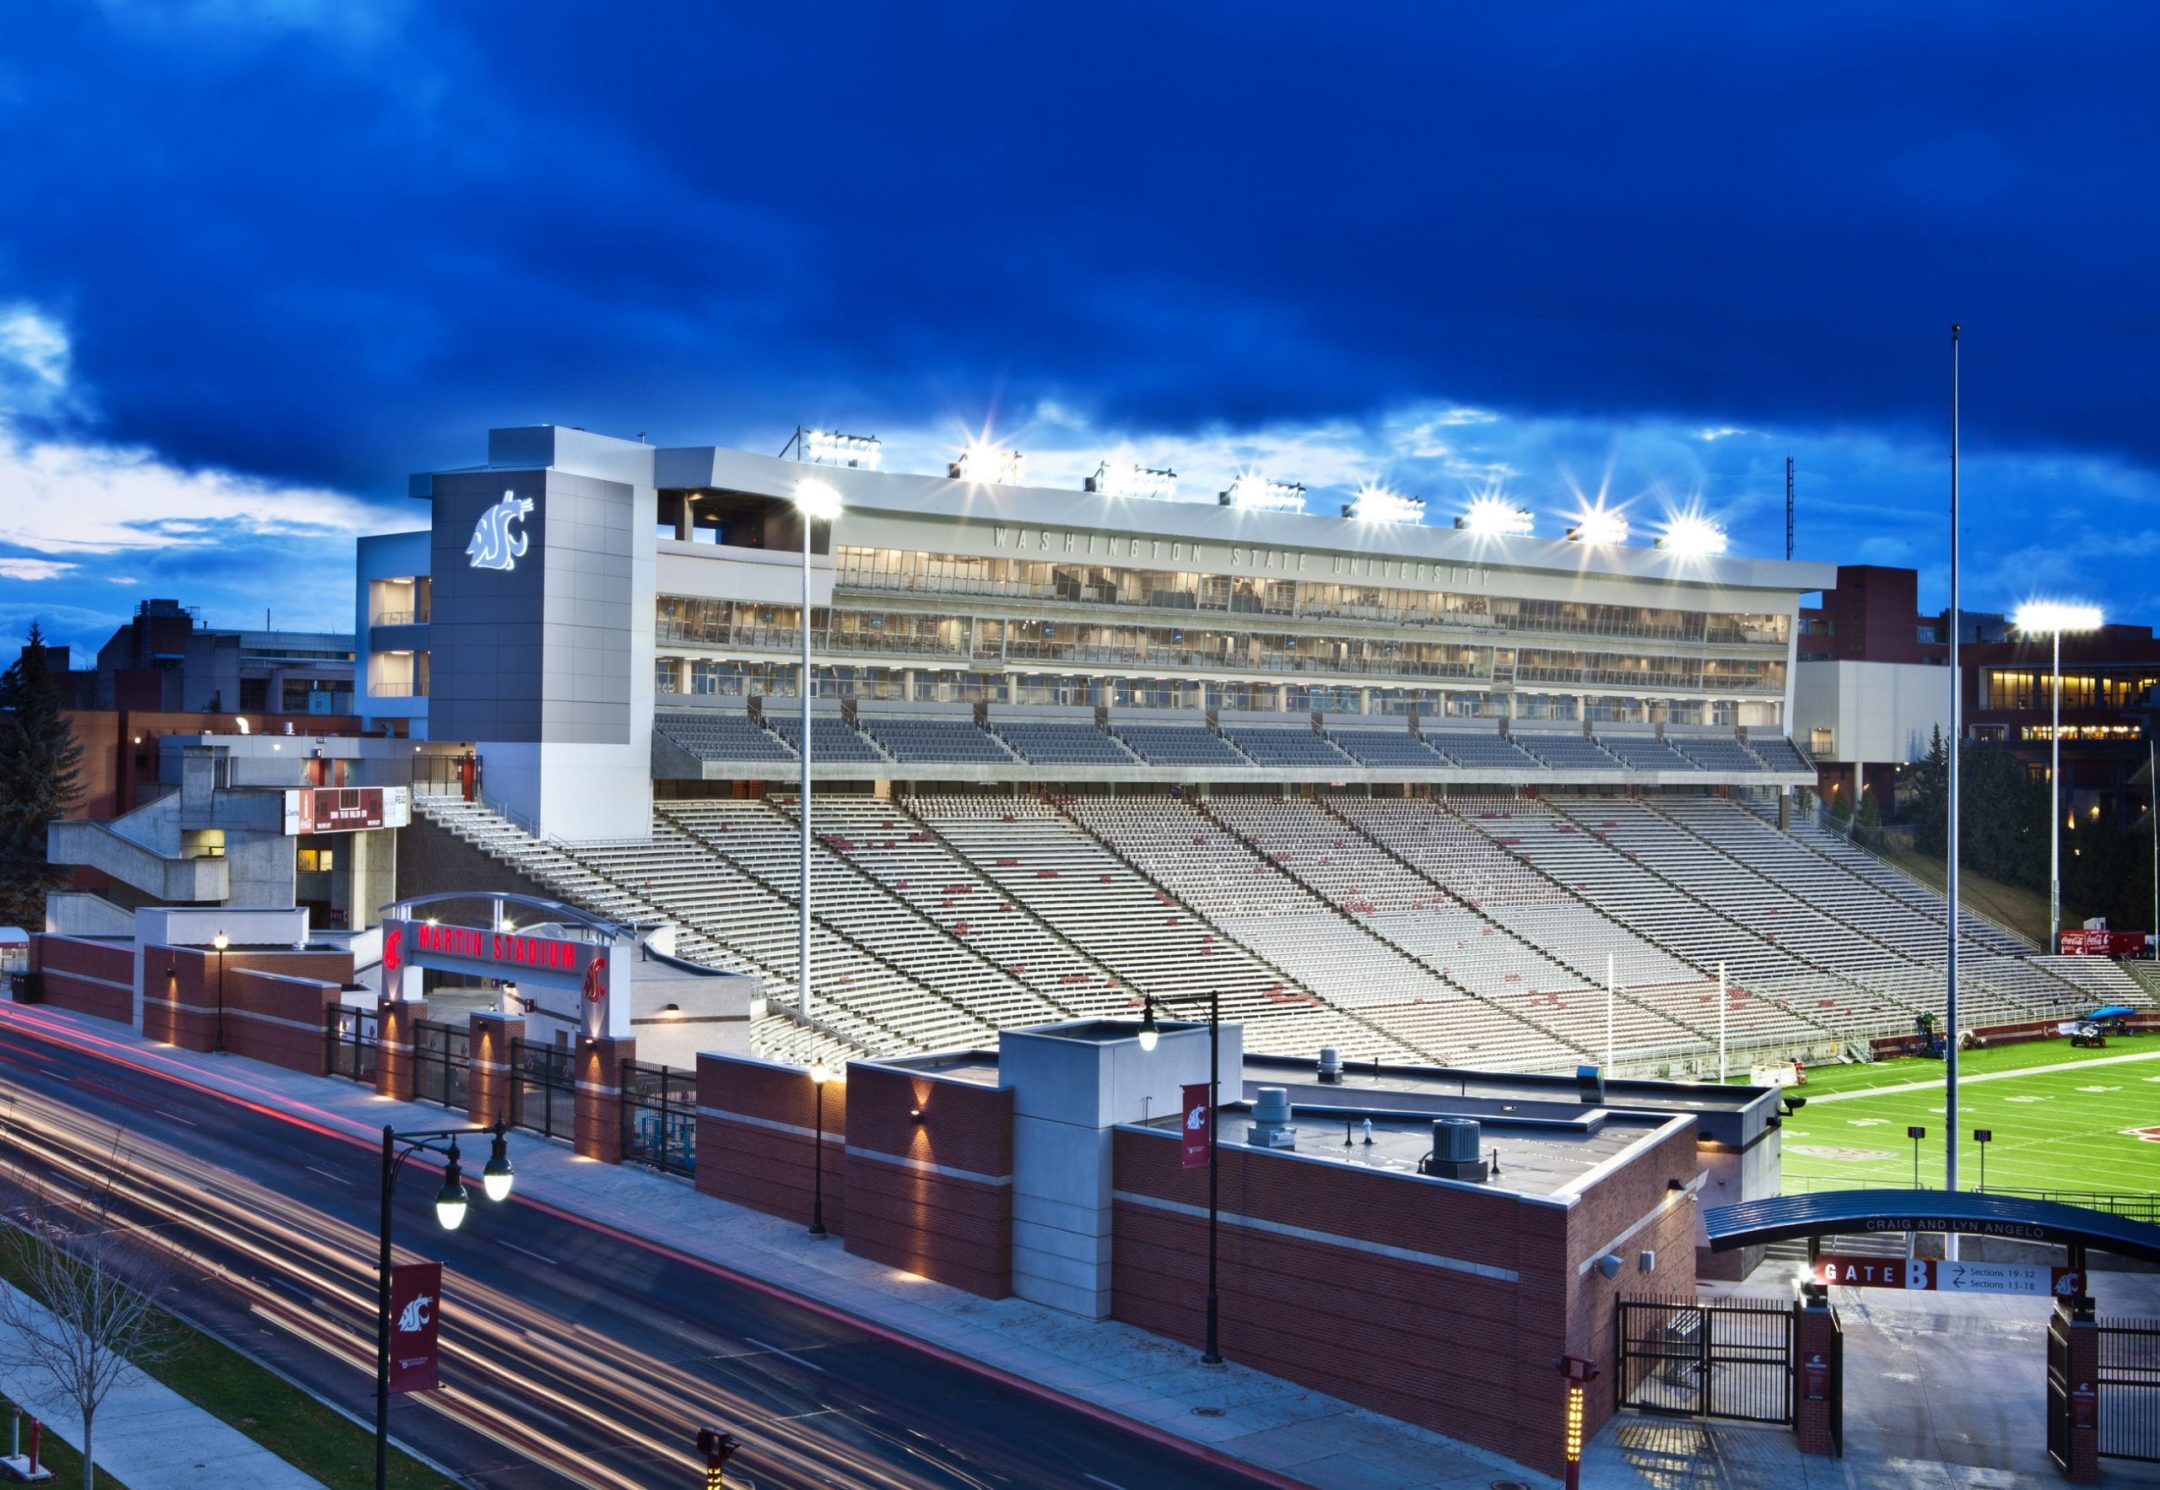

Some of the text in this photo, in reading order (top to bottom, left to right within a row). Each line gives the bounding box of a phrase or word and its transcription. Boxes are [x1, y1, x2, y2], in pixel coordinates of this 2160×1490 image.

[994, 526, 1491, 586] WASHINGTON STATE UNIVERSITY
[419, 924, 575, 969] MARTIN STADIUM
[1866, 1219, 2044, 1238] CRAIG AND LYN ANGELO
[1824, 1259, 1928, 1291] GATE B
[1970, 1268, 2036, 1279] Sections 19-32
[1970, 1279, 2004, 1290] Sections
